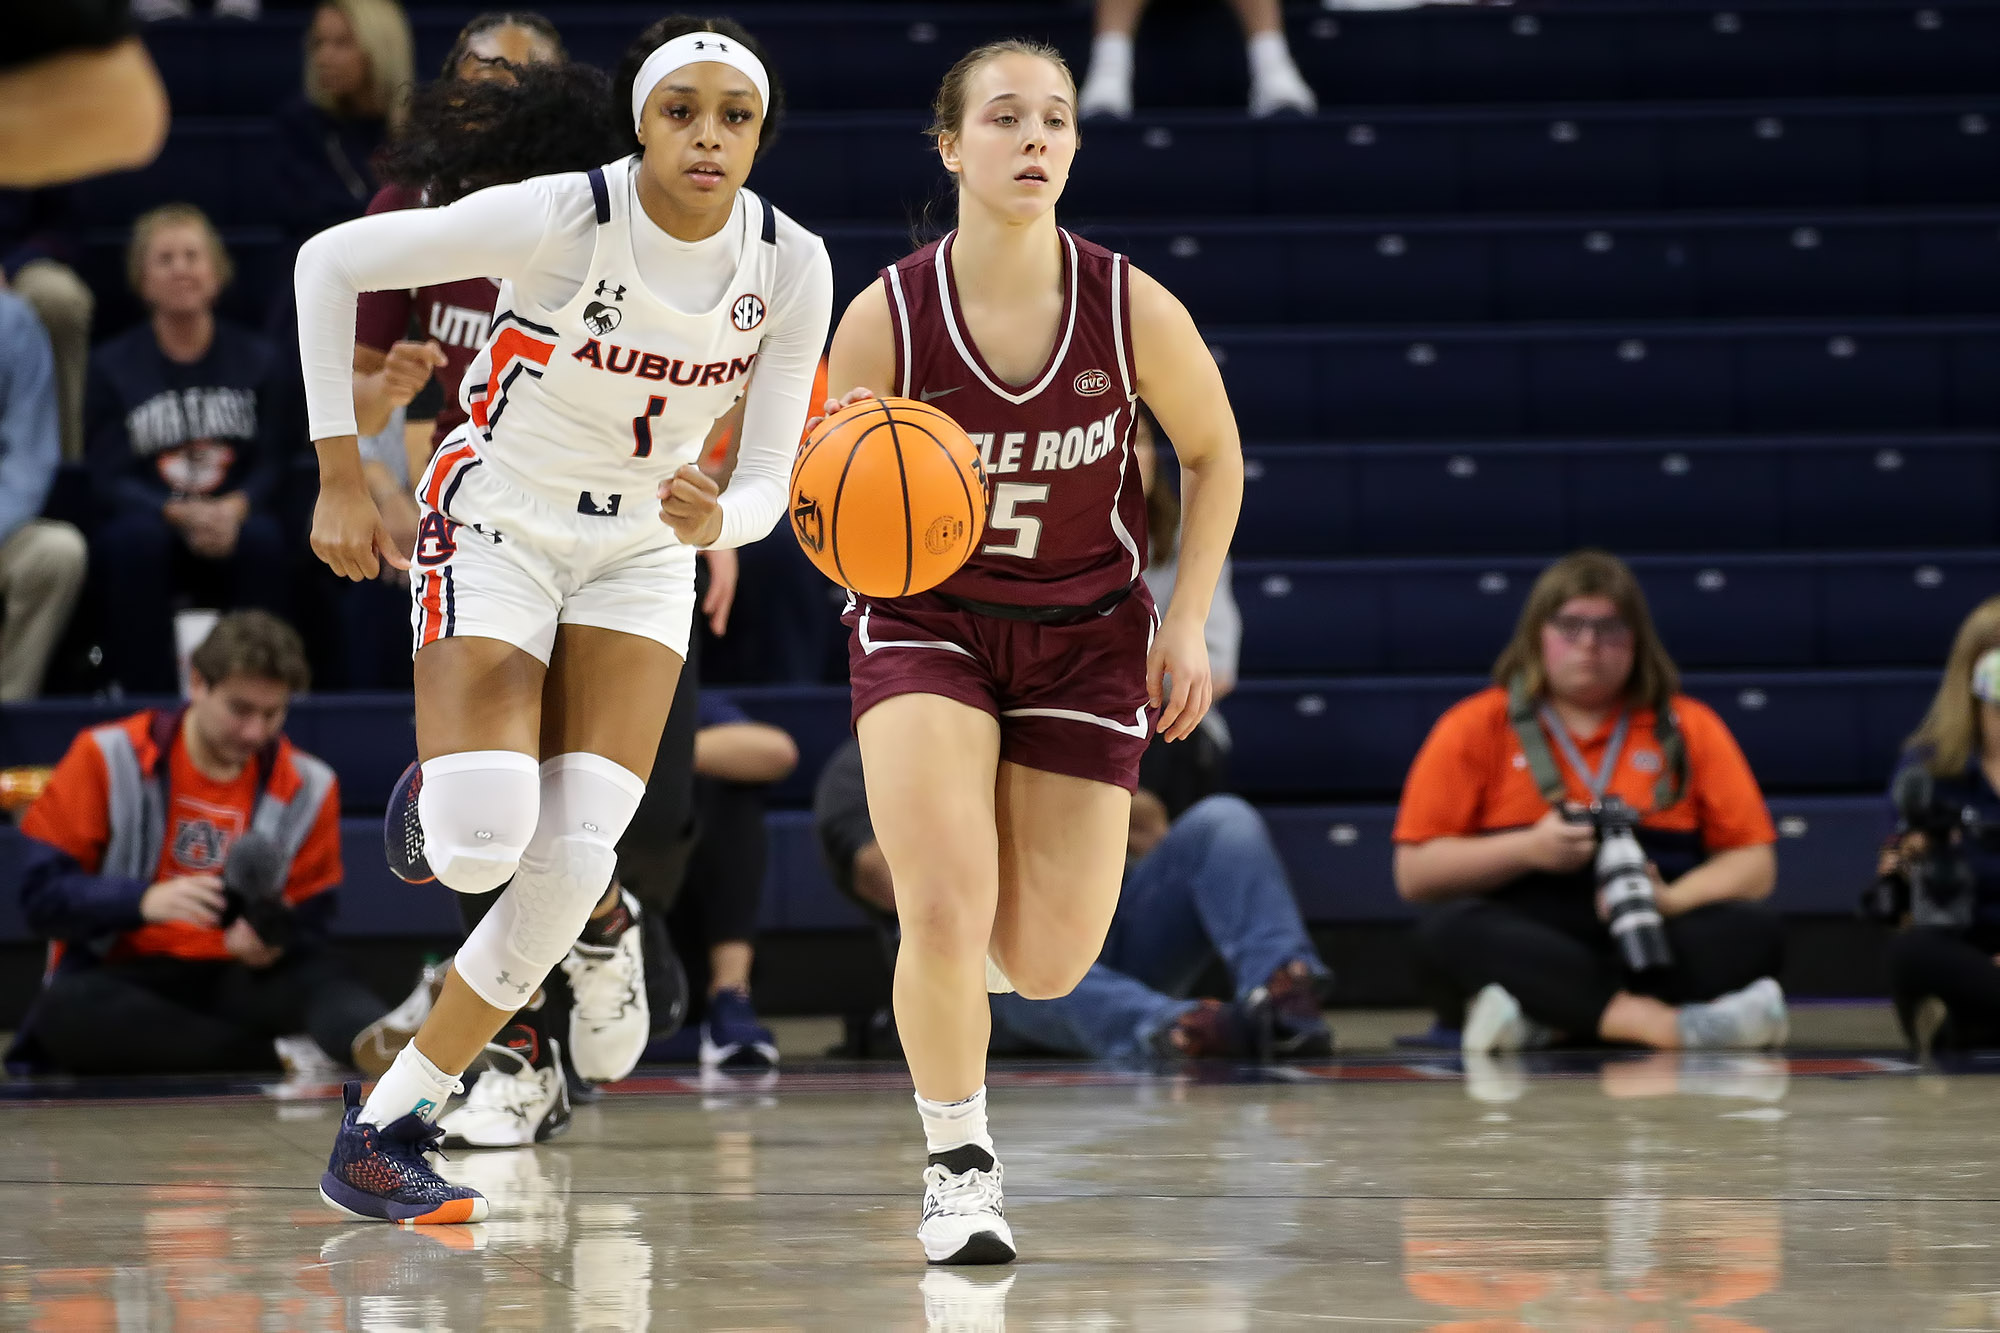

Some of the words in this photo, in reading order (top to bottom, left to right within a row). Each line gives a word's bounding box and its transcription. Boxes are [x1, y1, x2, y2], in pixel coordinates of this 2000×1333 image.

[733, 296, 764, 330] SEC
[571, 337, 759, 387] AUBURN
[1081, 376, 1104, 390] OVC
[632, 394, 667, 458] 1
[1031, 406, 1122, 472] ROCK
[981, 482, 1051, 559] 5
